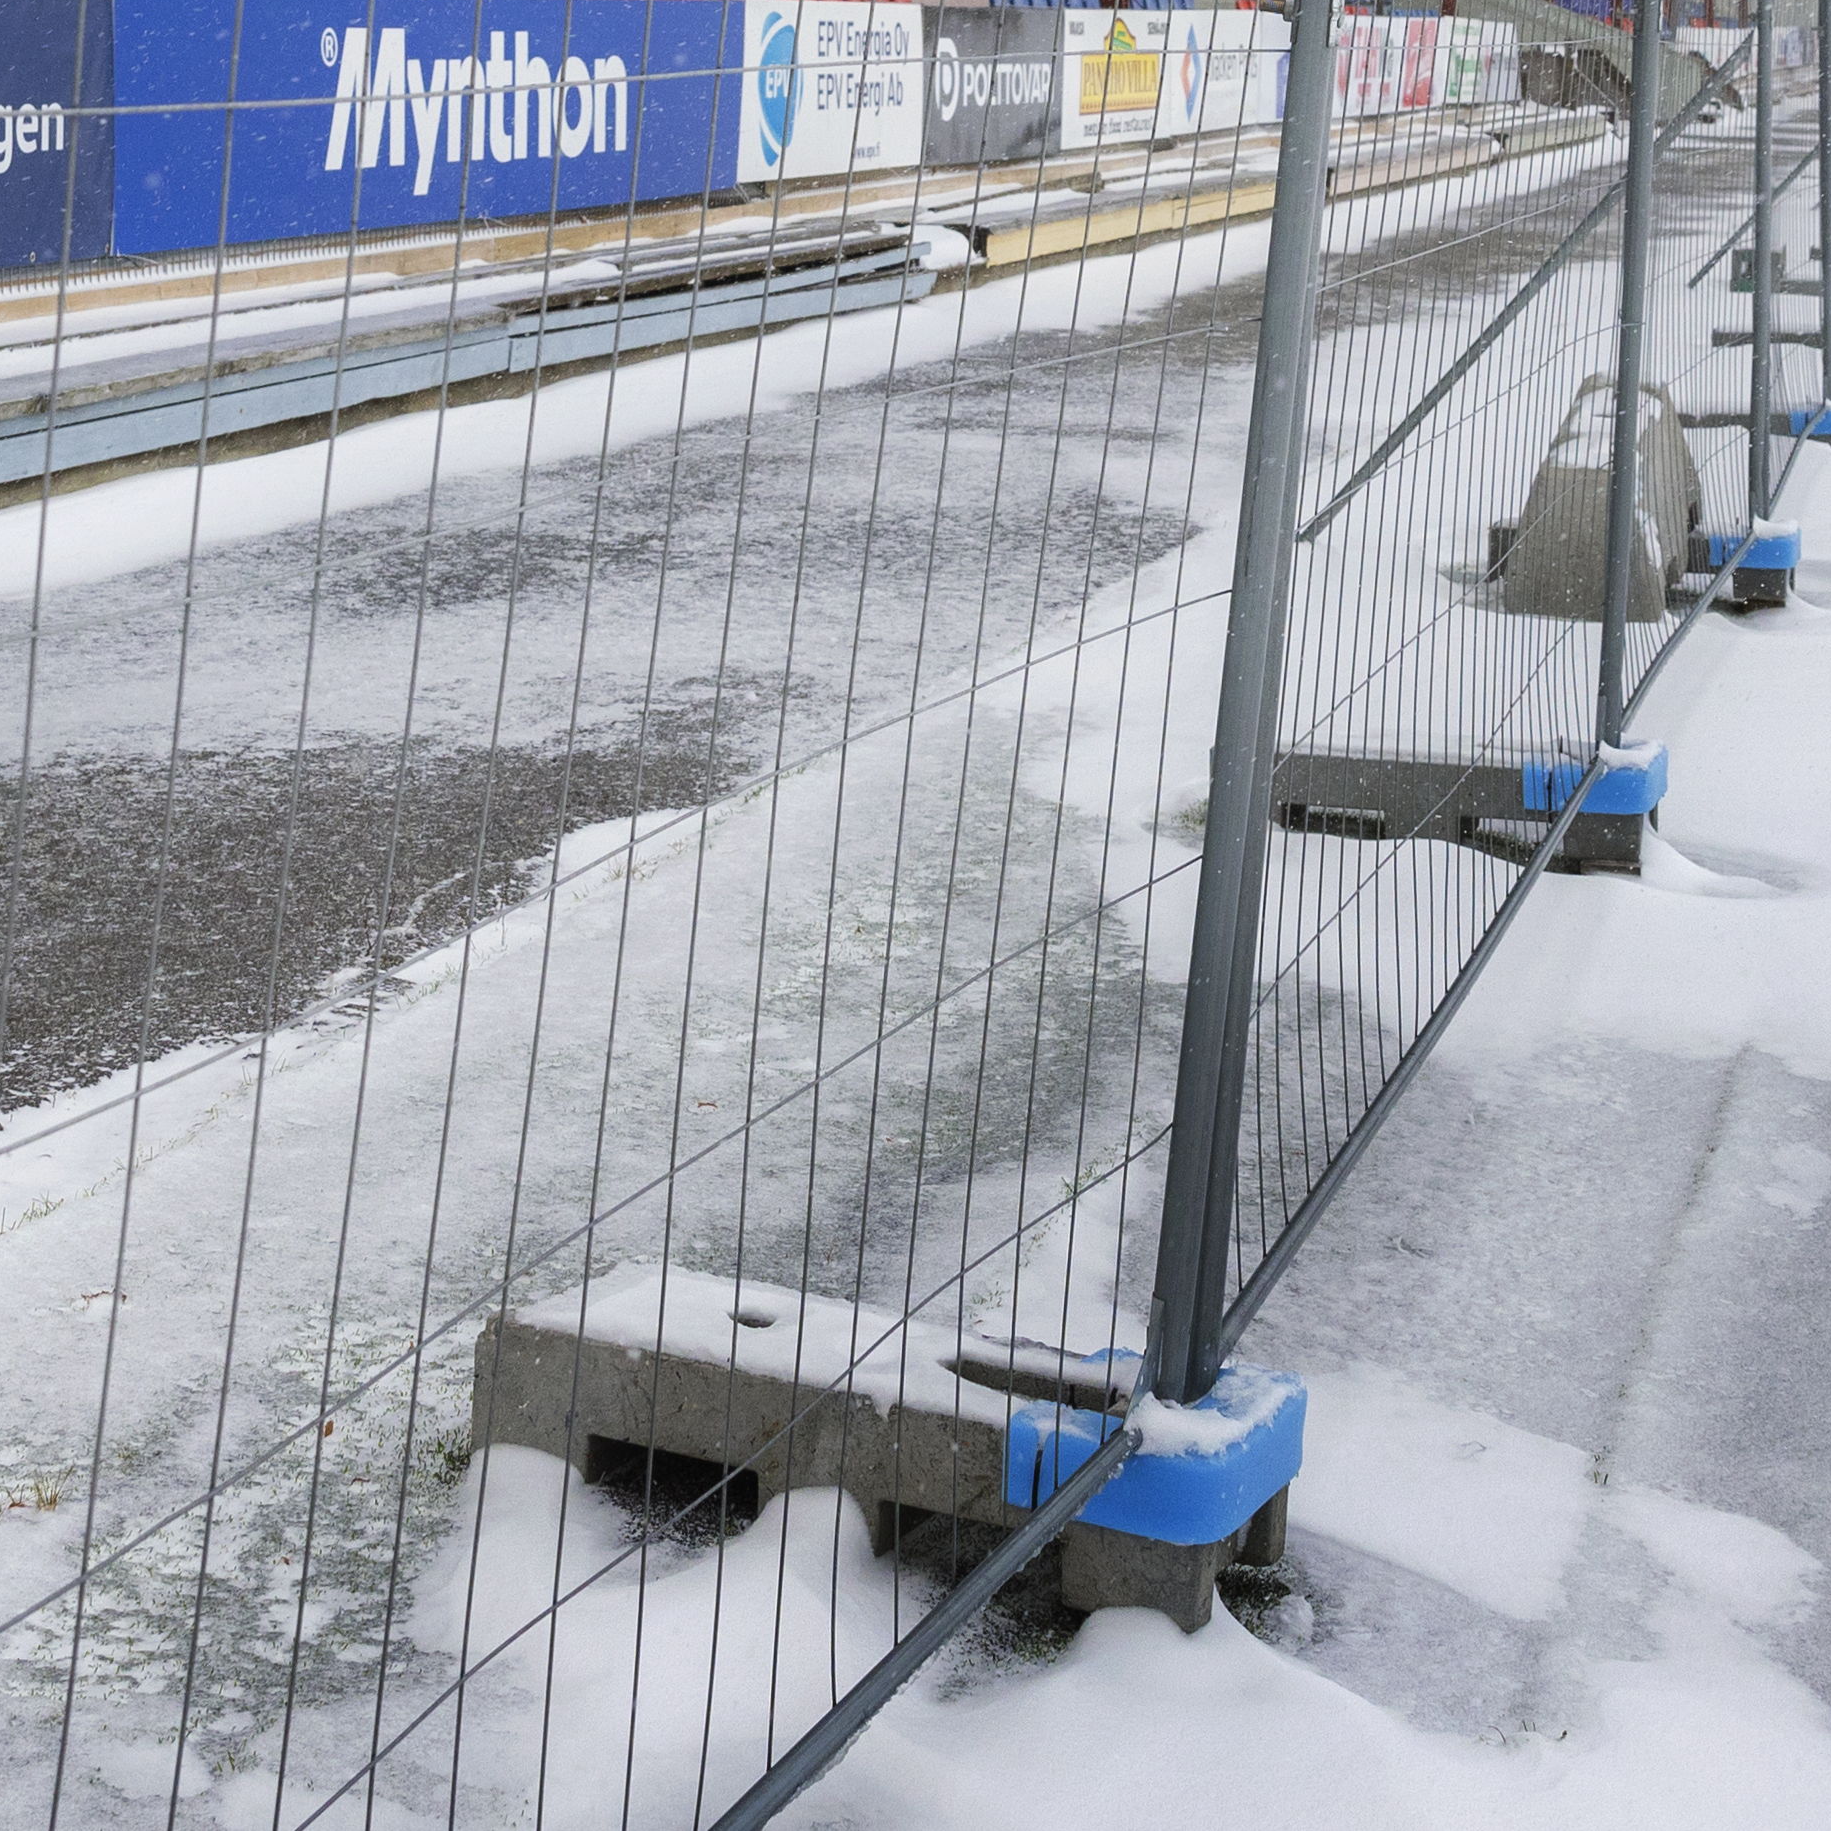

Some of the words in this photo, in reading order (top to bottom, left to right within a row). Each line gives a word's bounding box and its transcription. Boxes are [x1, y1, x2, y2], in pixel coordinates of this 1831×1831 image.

[817, 20, 844, 58] EPV
[895, 21, 910, 65] Oy
[817, 73, 844, 110] EPV
[887, 71, 904, 107] Ab
[1083, 60, 1126, 97] PANHO
[1126, 59, 1158, 94] VILLA
[325, 25, 629, 197] Mynthon
